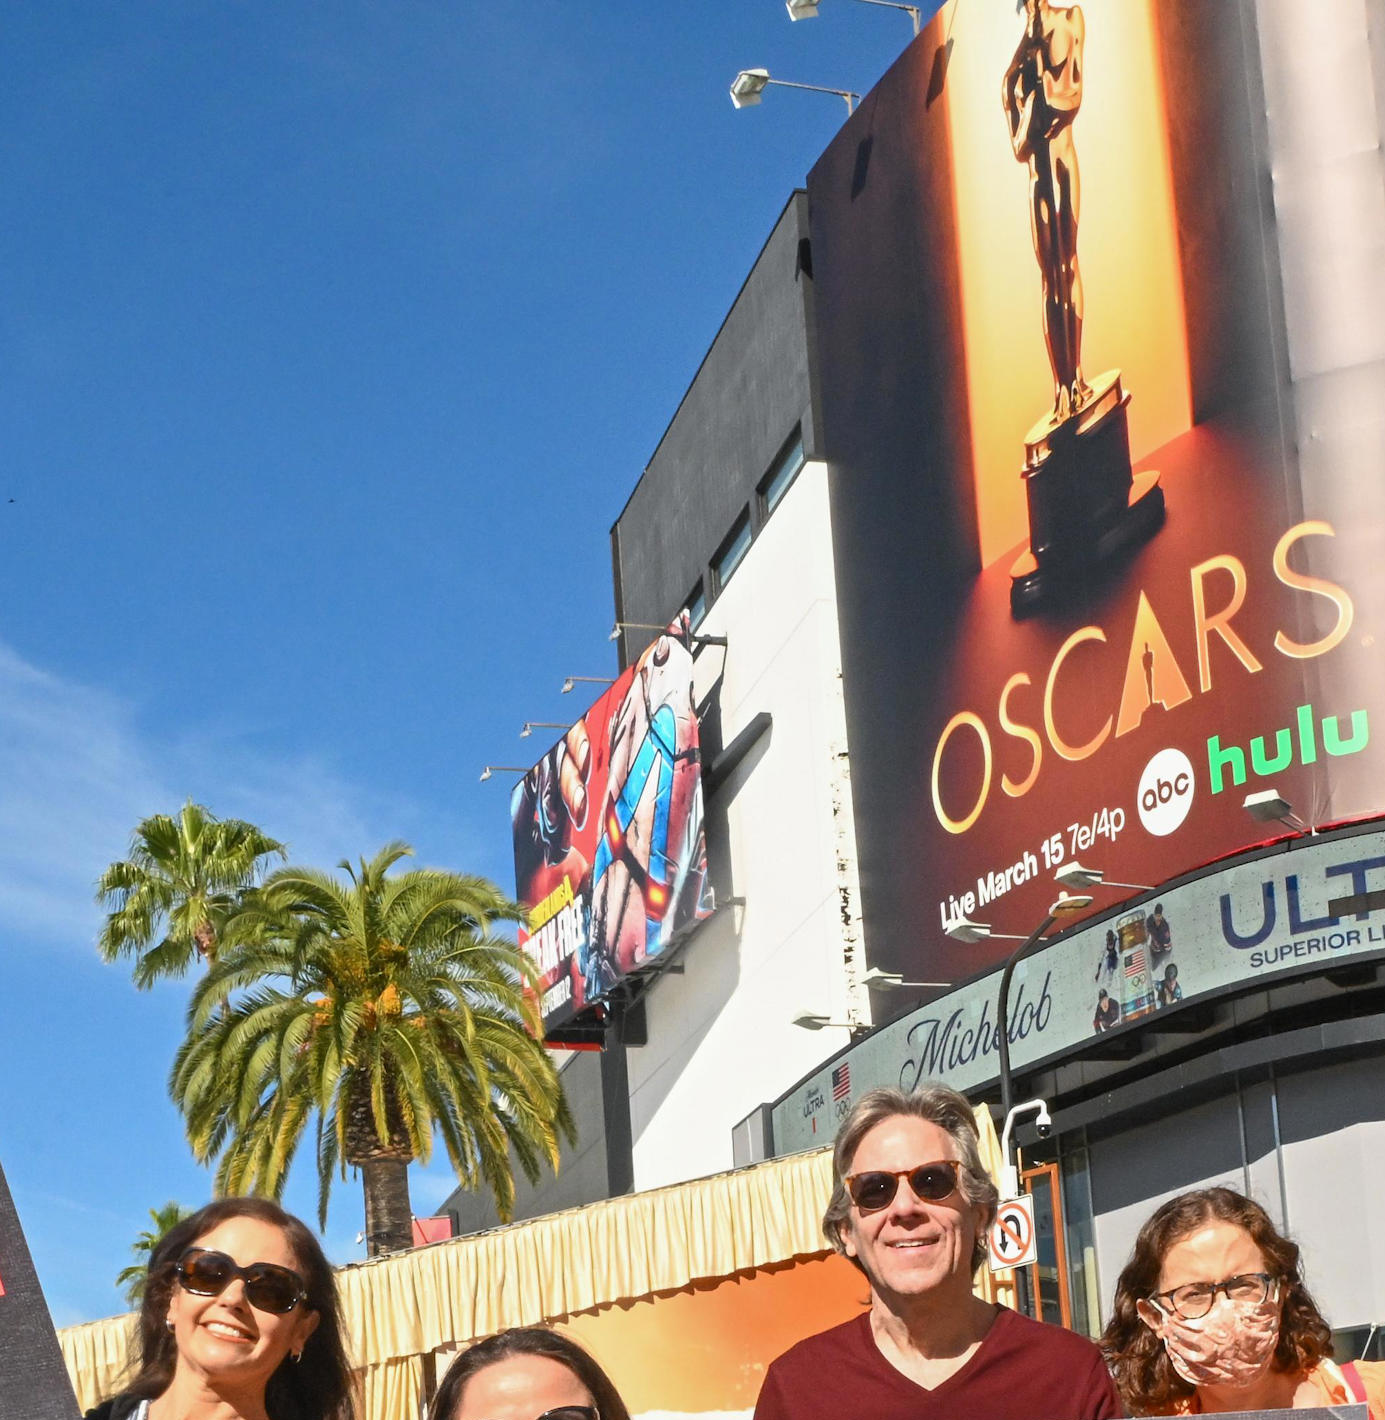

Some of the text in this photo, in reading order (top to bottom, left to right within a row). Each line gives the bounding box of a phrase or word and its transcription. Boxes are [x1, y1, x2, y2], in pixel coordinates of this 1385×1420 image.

[931, 520, 1354, 835] OSCARS
[1207, 704, 1370, 795] hulu
[1142, 770, 1189, 812] abc
[940, 807, 1125, 930] Live March 15 7e/4p
[1250, 930, 1361, 968] SUPERIOR
[803, 1094, 824, 1118] ULTRA
